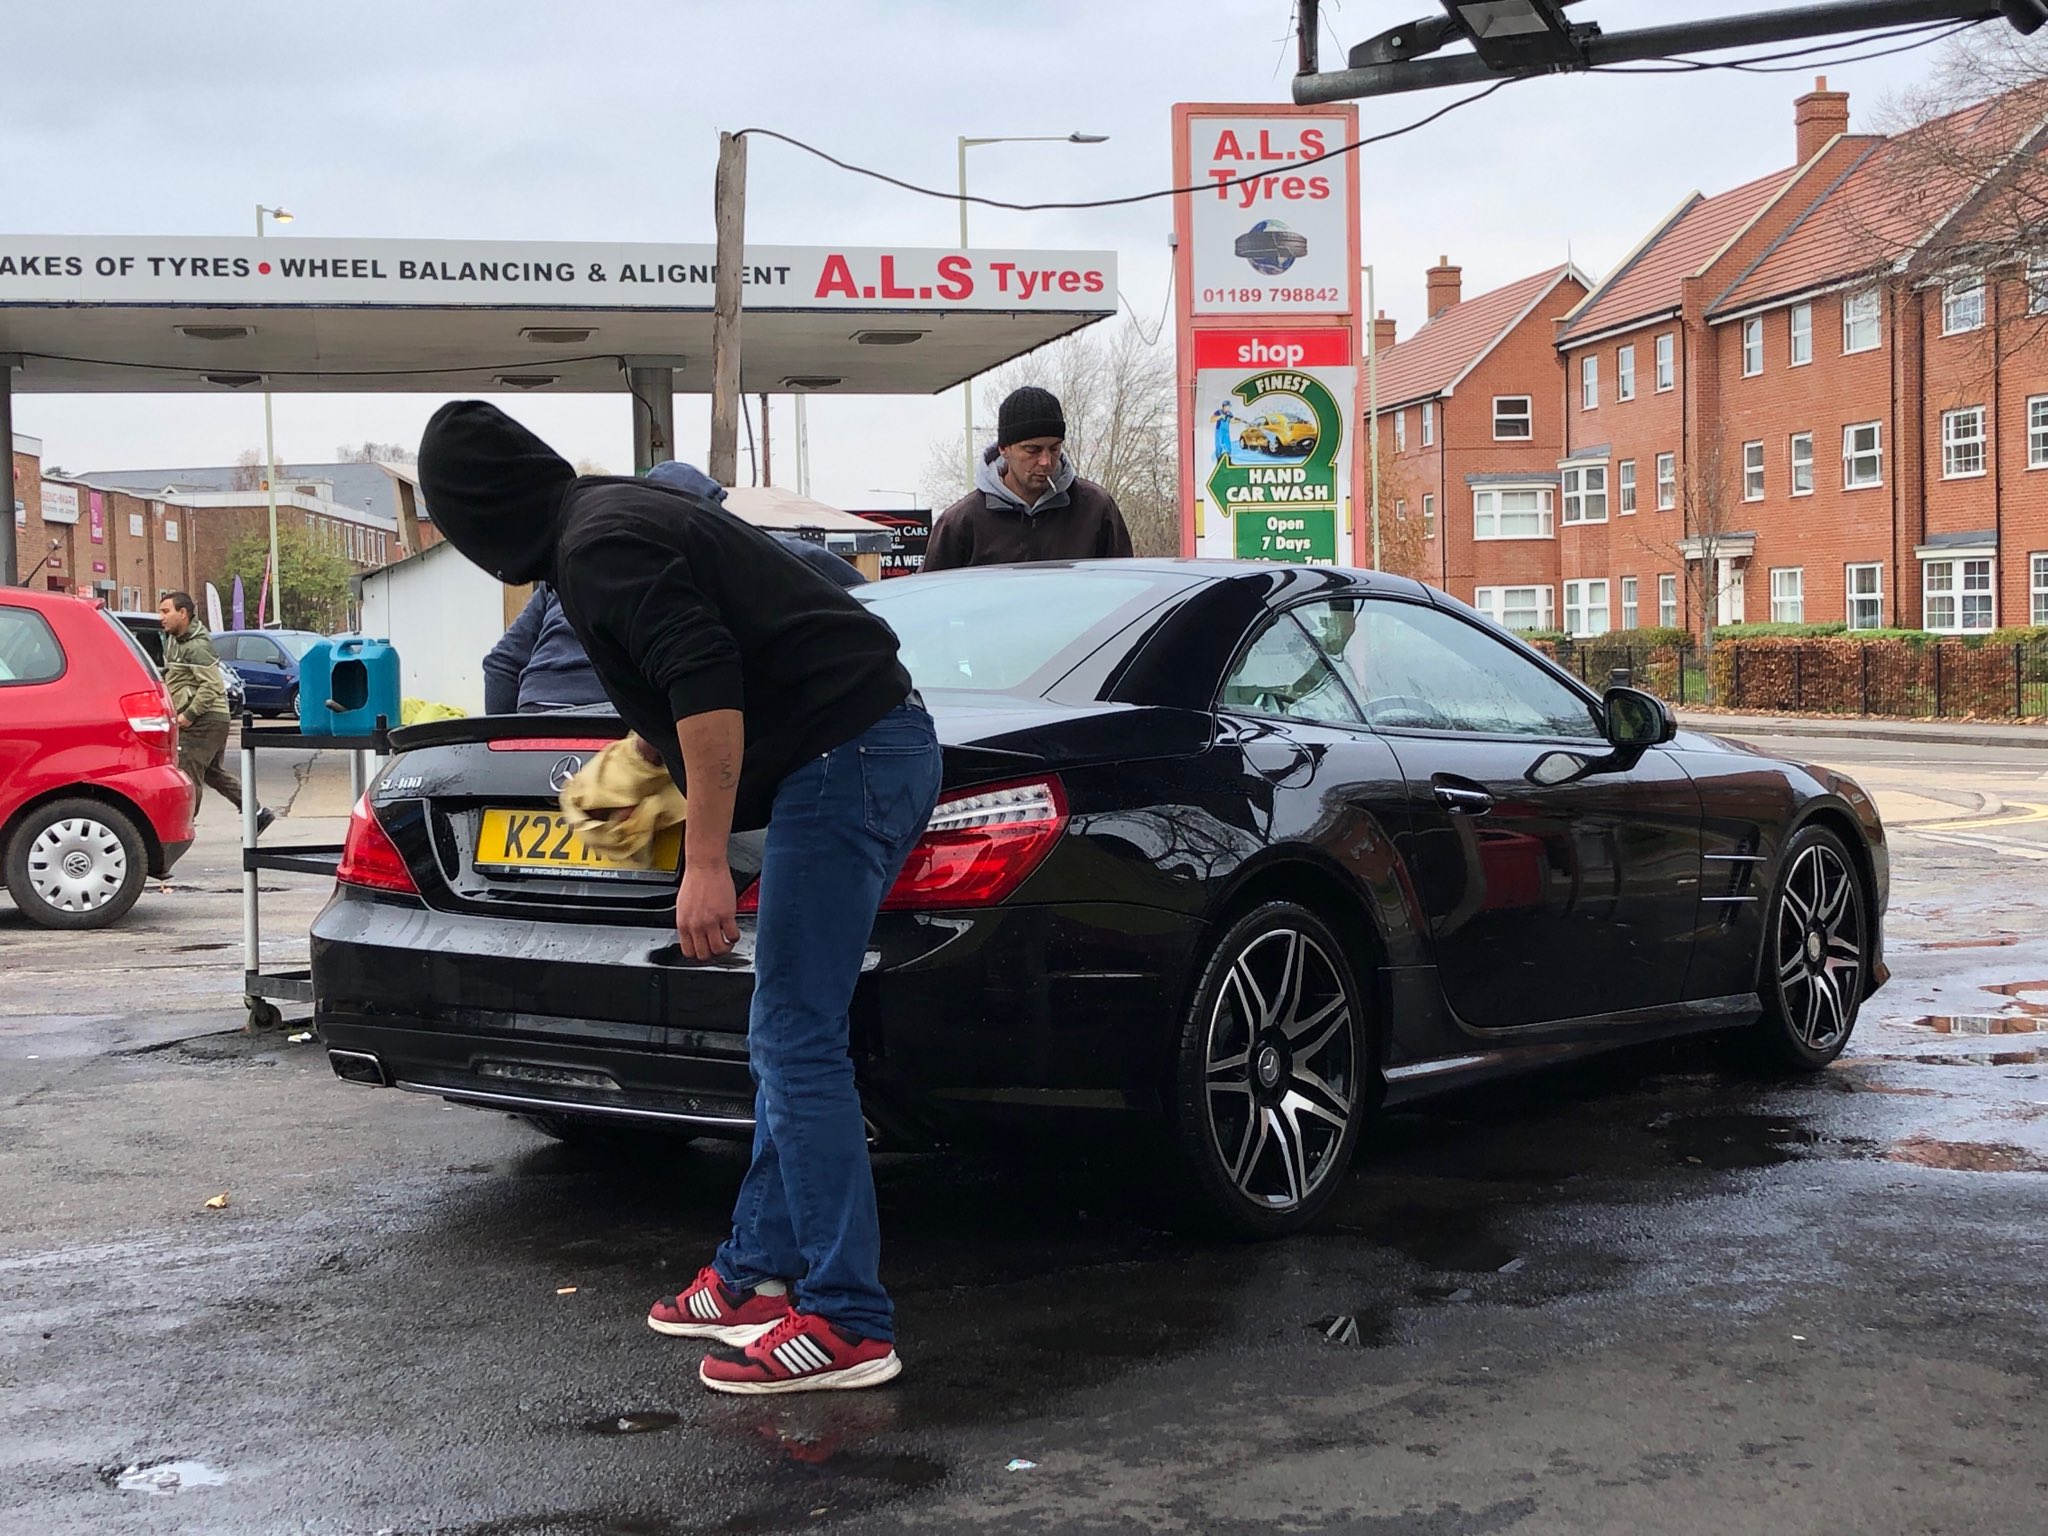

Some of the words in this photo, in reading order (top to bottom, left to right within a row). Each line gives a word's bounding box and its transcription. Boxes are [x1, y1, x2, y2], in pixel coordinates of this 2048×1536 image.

[1213, 129, 1325, 160] A.L.S
[1208, 169, 1330, 208] Tyres
[95, 256, 135, 276] OF
[147, 257, 250, 277] TYRES
[280, 258, 387, 279] WHEEL
[399, 260, 575, 282] BALANCING
[587, 263, 607, 282] &
[619, 264, 791, 285] ALIGNENT
[814, 254, 974, 300] A.L.S
[989, 262, 1105, 300] Tyres
[1203, 288, 1262, 302] 01189
[1269, 287, 1339, 302] 798842
[1238, 338, 1304, 367] shop
[1255, 374, 1311, 394] FINEST
[1249, 468, 1306, 484] HAND
[1226, 486, 1265, 502] CAR
[1270, 485, 1329, 501] WASH
[1266, 516, 1304, 533] Open
[1261, 536, 1272, 550] 7
[1275, 536, 1311, 553] Days
[894, 555, 902, 567] A
[903, 555, 926, 567] WEE
[503, 814, 575, 860] K22
